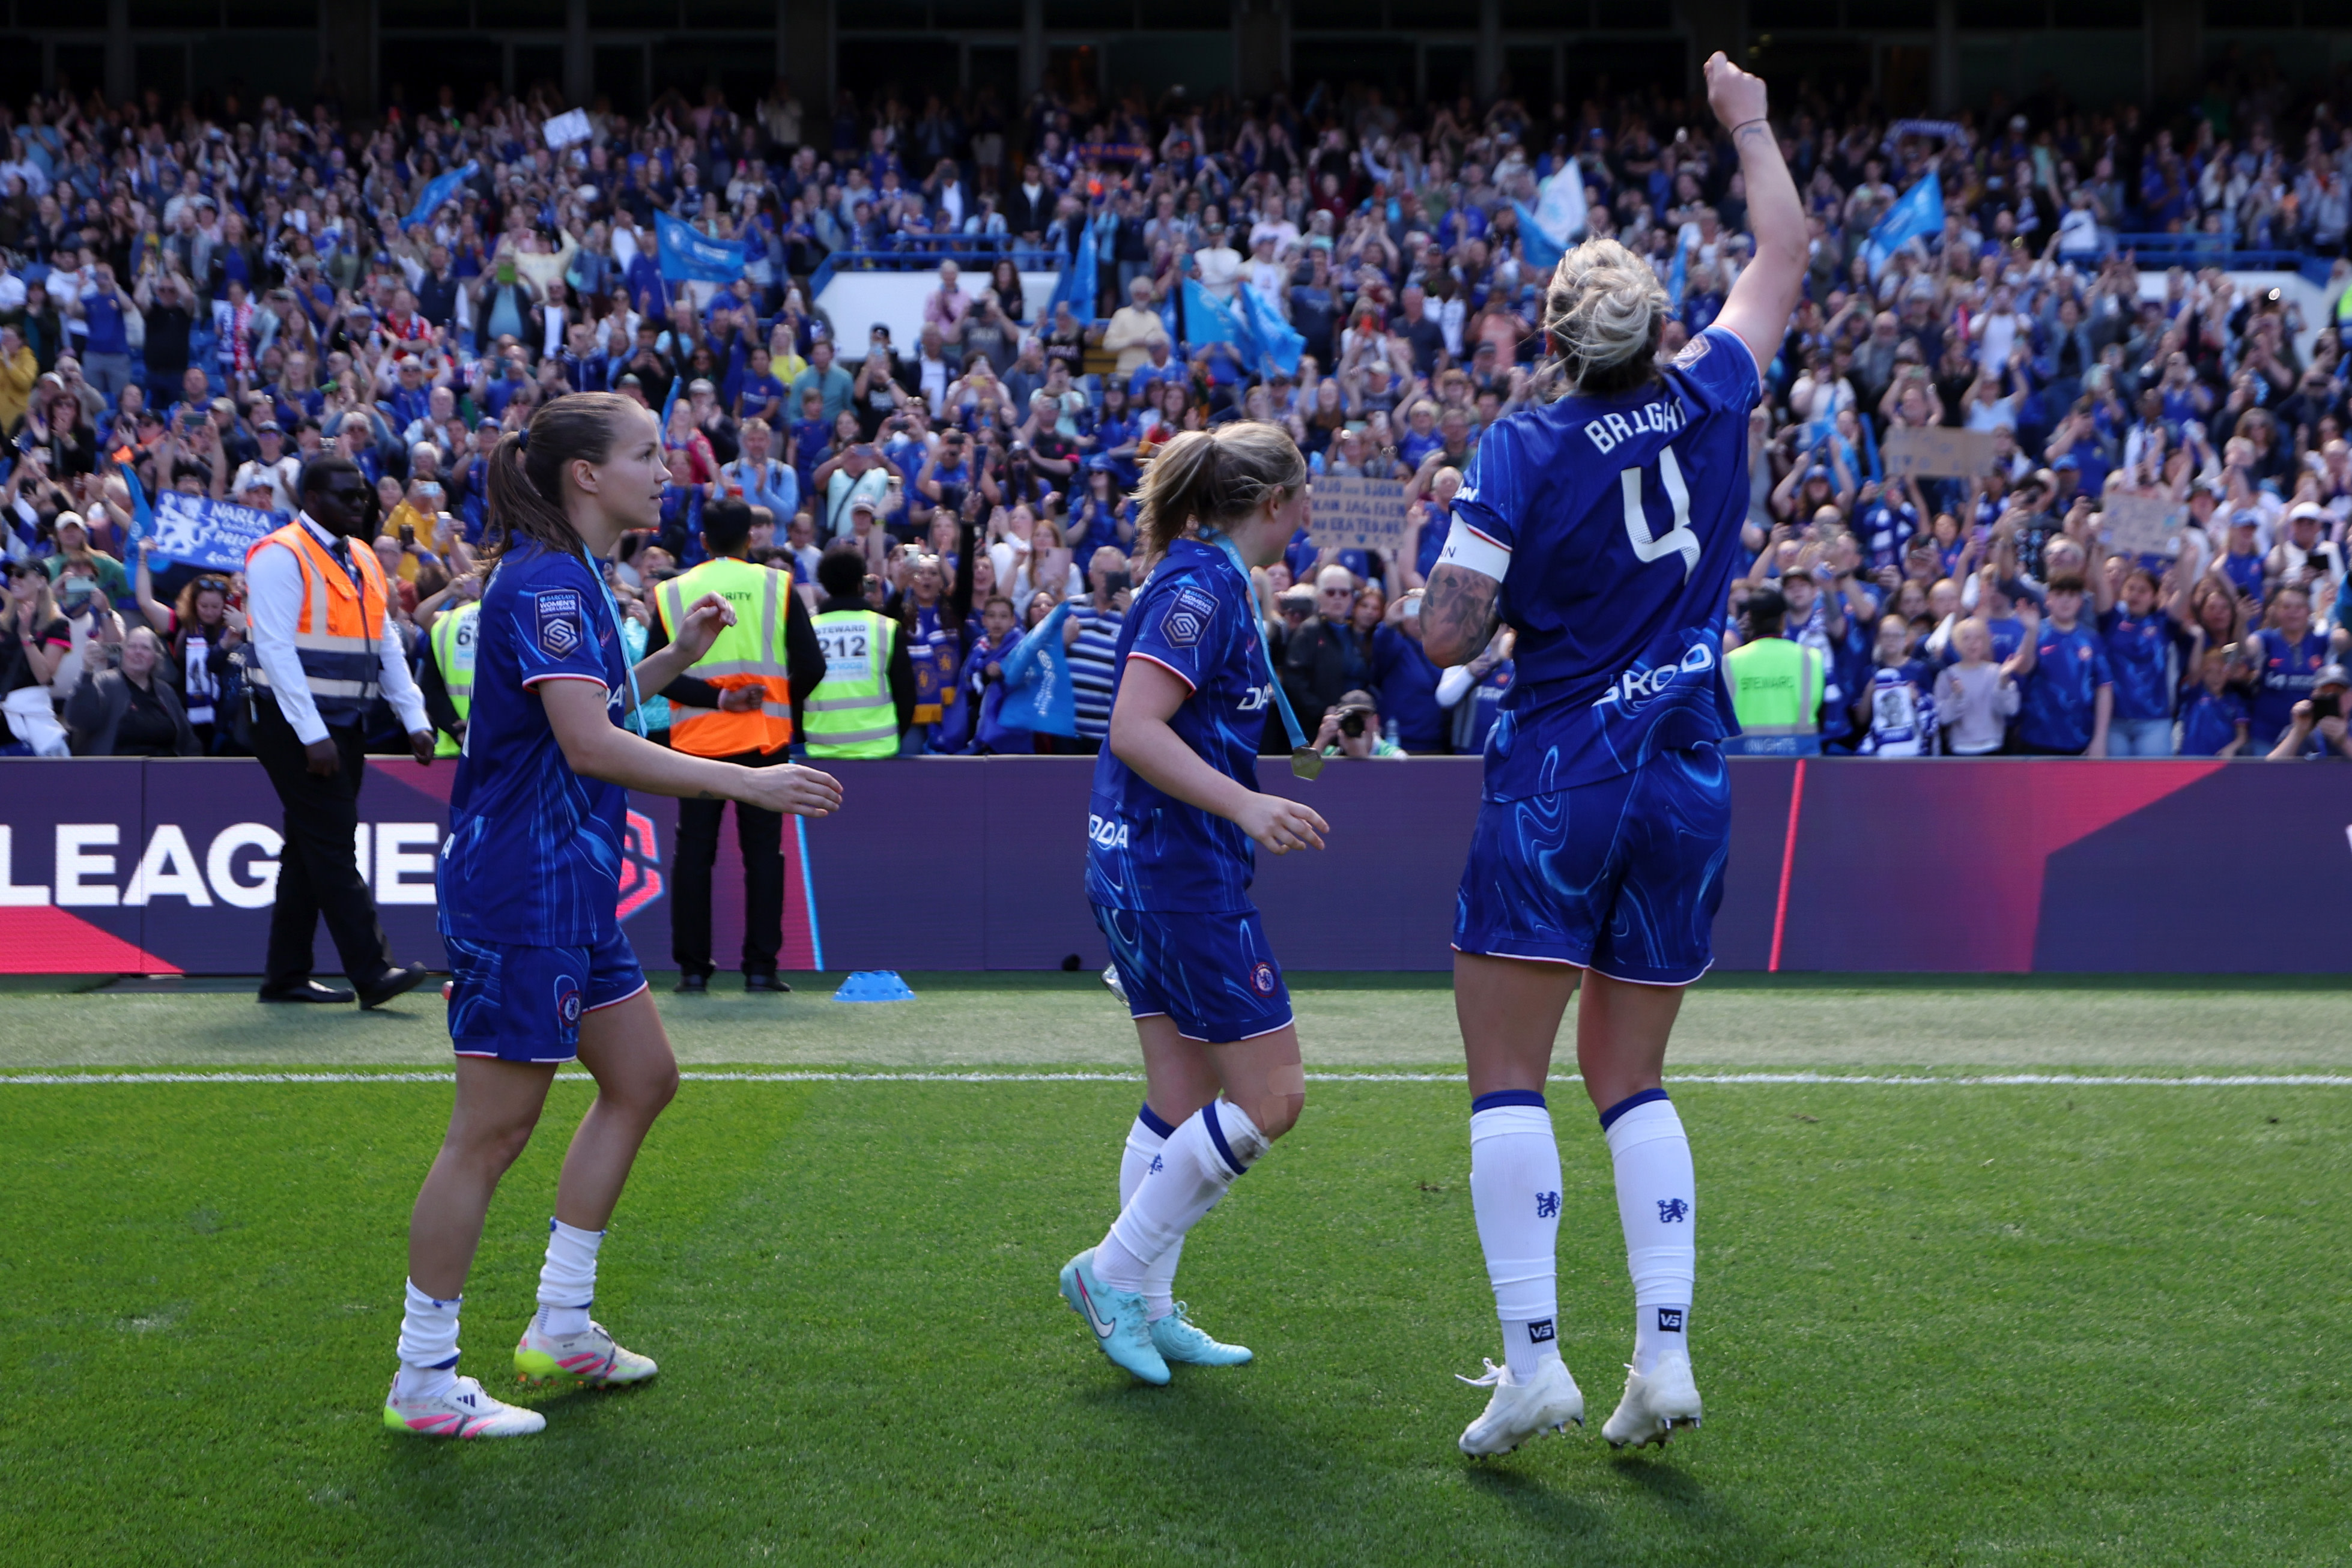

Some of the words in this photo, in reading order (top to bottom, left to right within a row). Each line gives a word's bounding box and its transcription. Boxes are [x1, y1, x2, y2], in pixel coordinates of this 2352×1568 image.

[1584, 396, 1687, 454] BRIGHT
[1620, 444, 1700, 586] 4
[540, 599, 576, 609] WOMEN'S
[721, 592, 751, 601] RITY
[1182, 593, 1212, 611] WOMEN'S
[1190, 590, 1214, 606] BARCLAYS
[816, 625, 865, 634] STEWARD
[818, 635, 866, 658] 212
